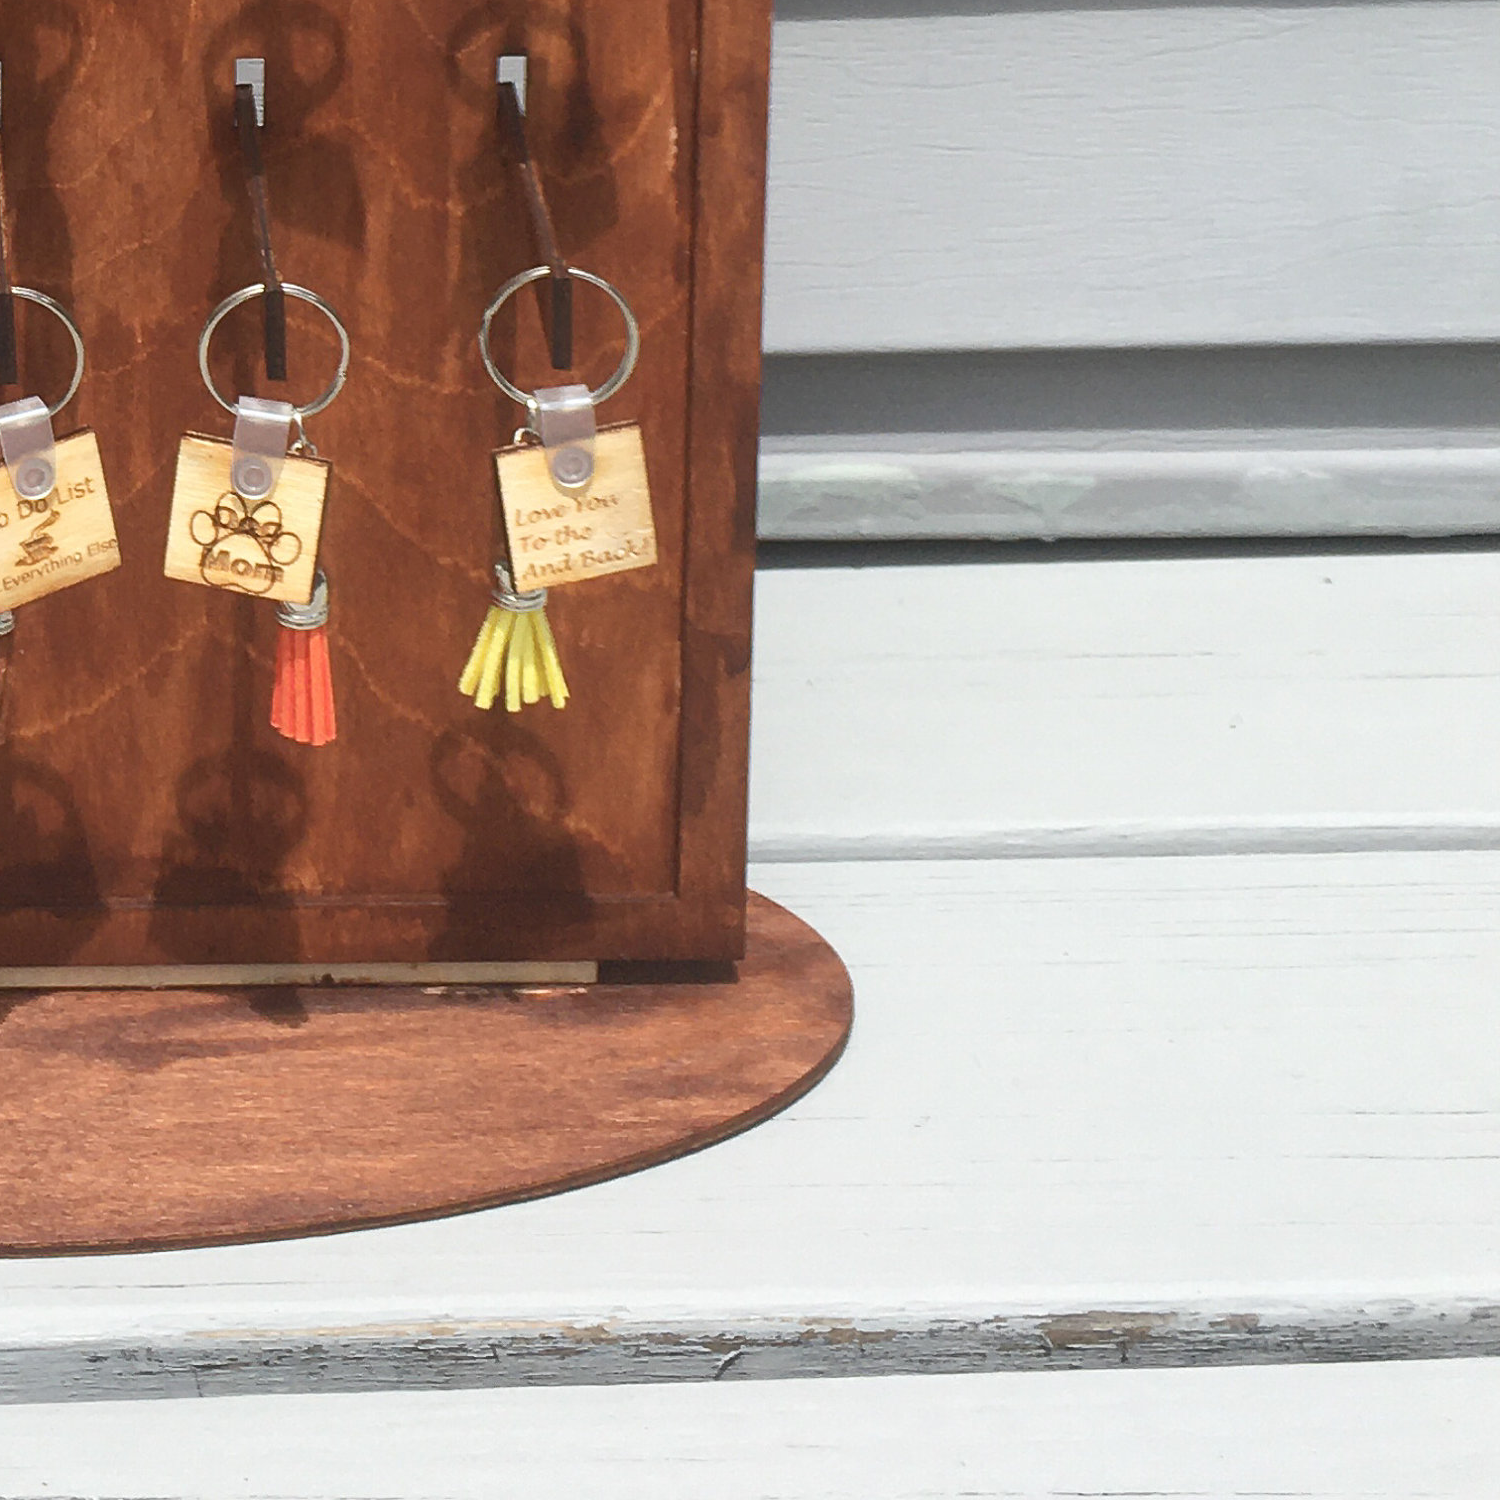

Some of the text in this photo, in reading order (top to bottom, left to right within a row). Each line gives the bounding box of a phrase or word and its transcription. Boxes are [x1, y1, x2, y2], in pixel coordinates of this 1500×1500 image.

[17, 499, 49, 520] Do
[54, 476, 97, 506] List
[515, 494, 619, 527] Love You
[518, 534, 548, 553] To
[522, 553, 572, 580] And
